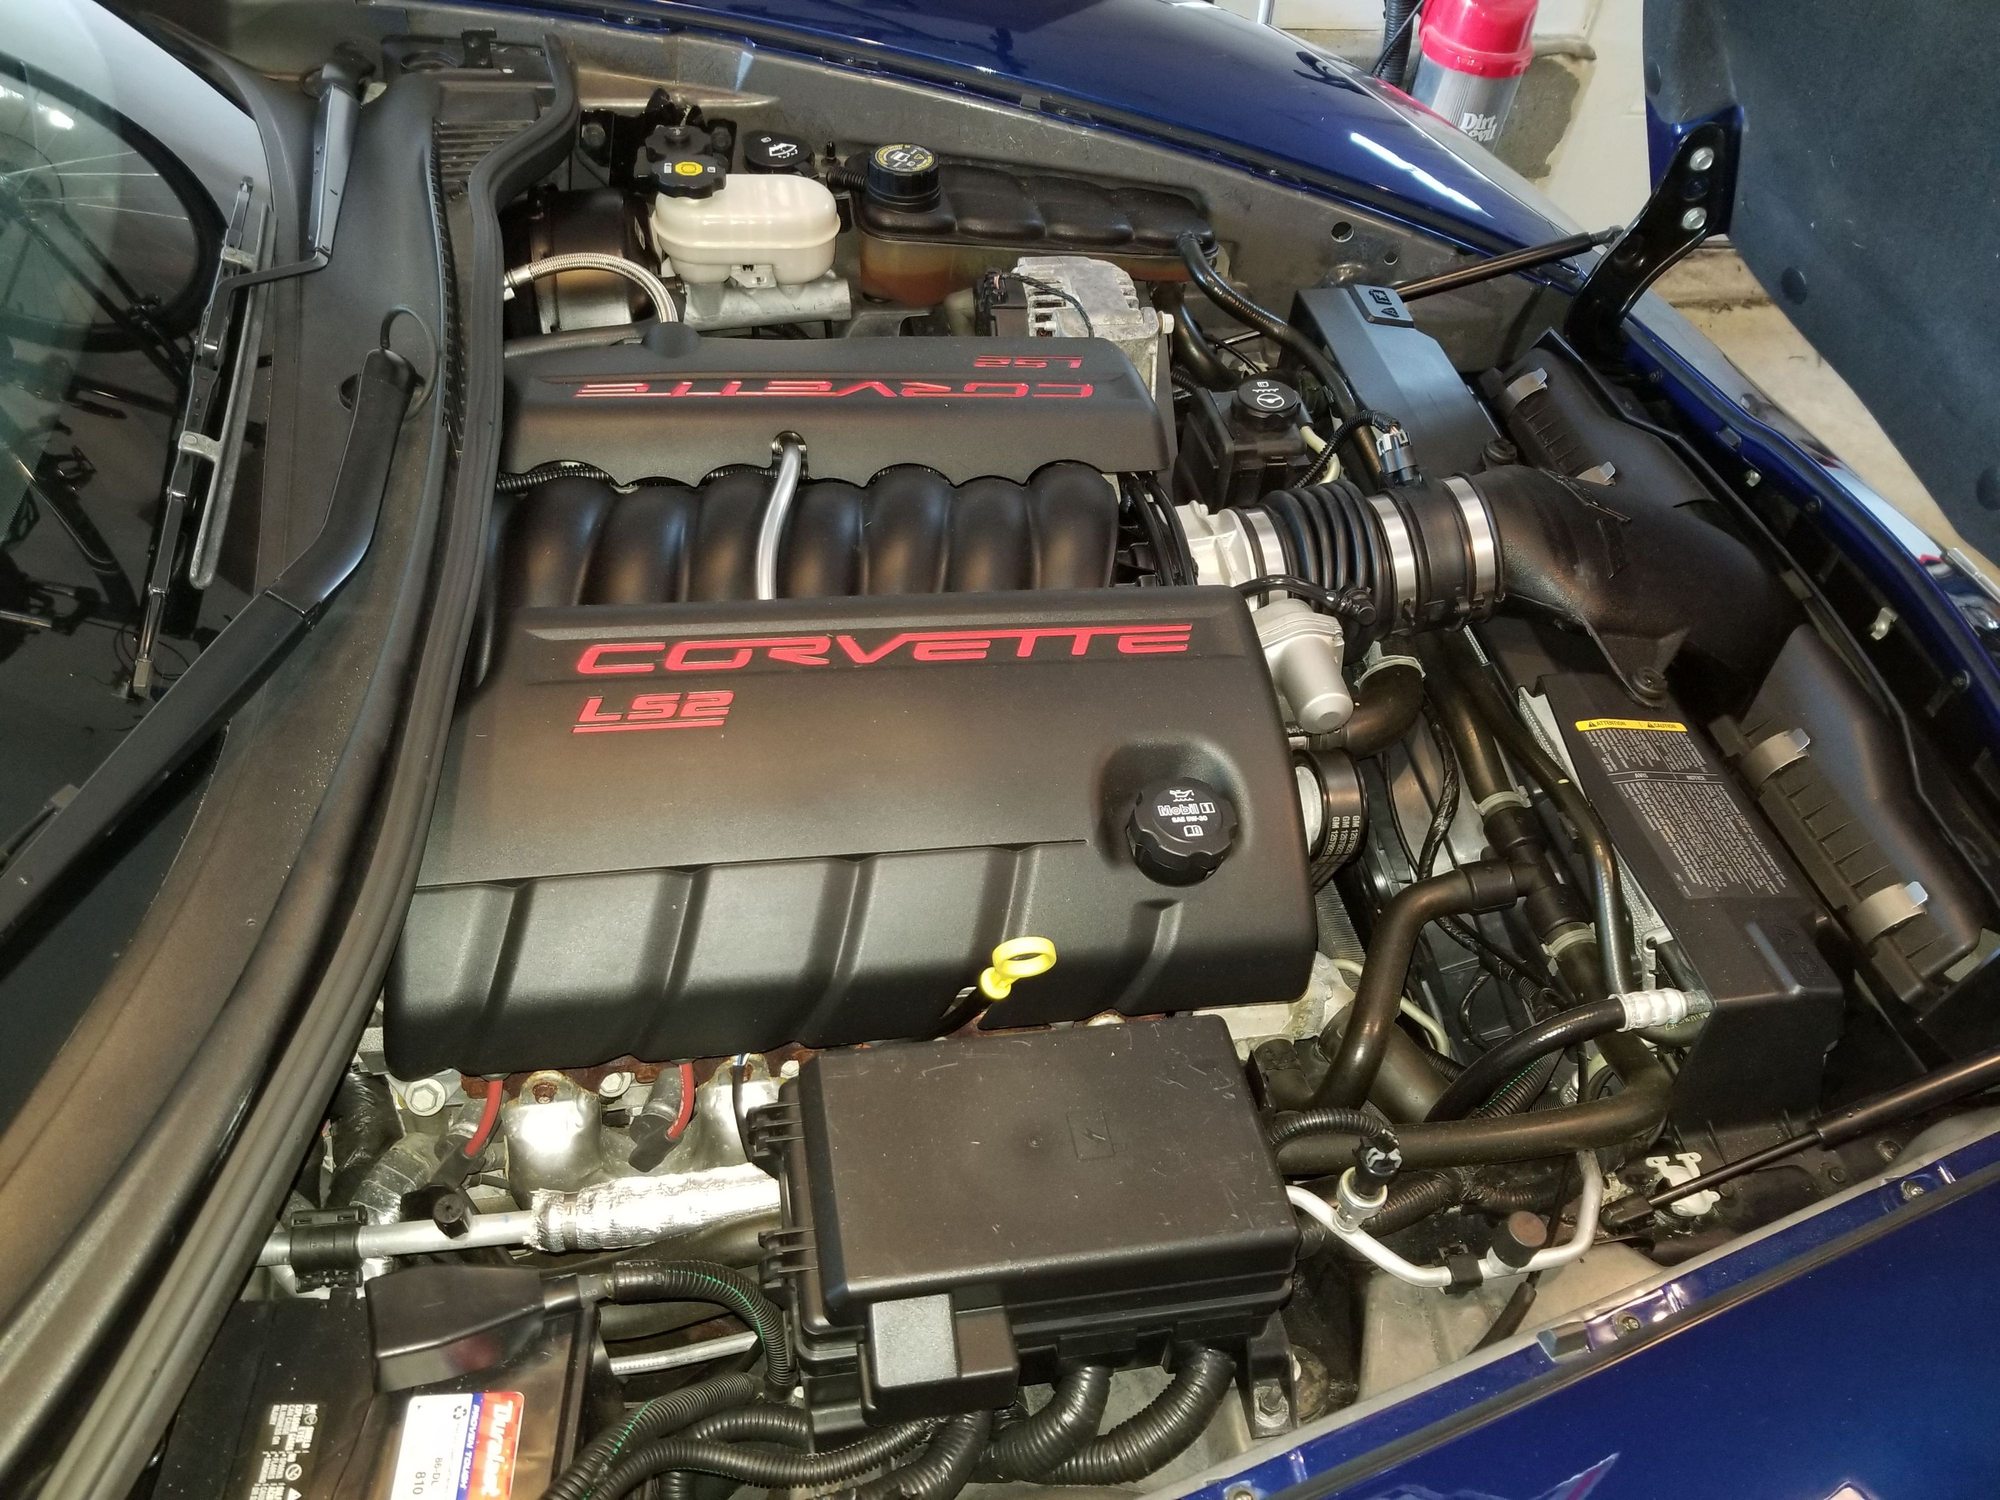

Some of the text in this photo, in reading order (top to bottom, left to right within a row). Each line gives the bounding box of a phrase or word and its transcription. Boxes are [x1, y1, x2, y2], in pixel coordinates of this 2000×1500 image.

[1460, 112, 1496, 130] Dirt
[1461, 123, 1497, 142] evil
[974, 355, 1084, 369] LS2
[573, 380, 1094, 399] CORVETTE
[576, 624, 1193, 675] CORVETTE
[572, 689, 735, 733] LS2
[1157, 803, 1200, 817] Mobil
[1331, 816, 1340, 829] GM
[1341, 816, 1350, 828] GM
[1352, 815, 1360, 828] GM
[460, 1404, 480, 1490] PROVEN TOUGH
[412, 1471, 427, 1495] 810
